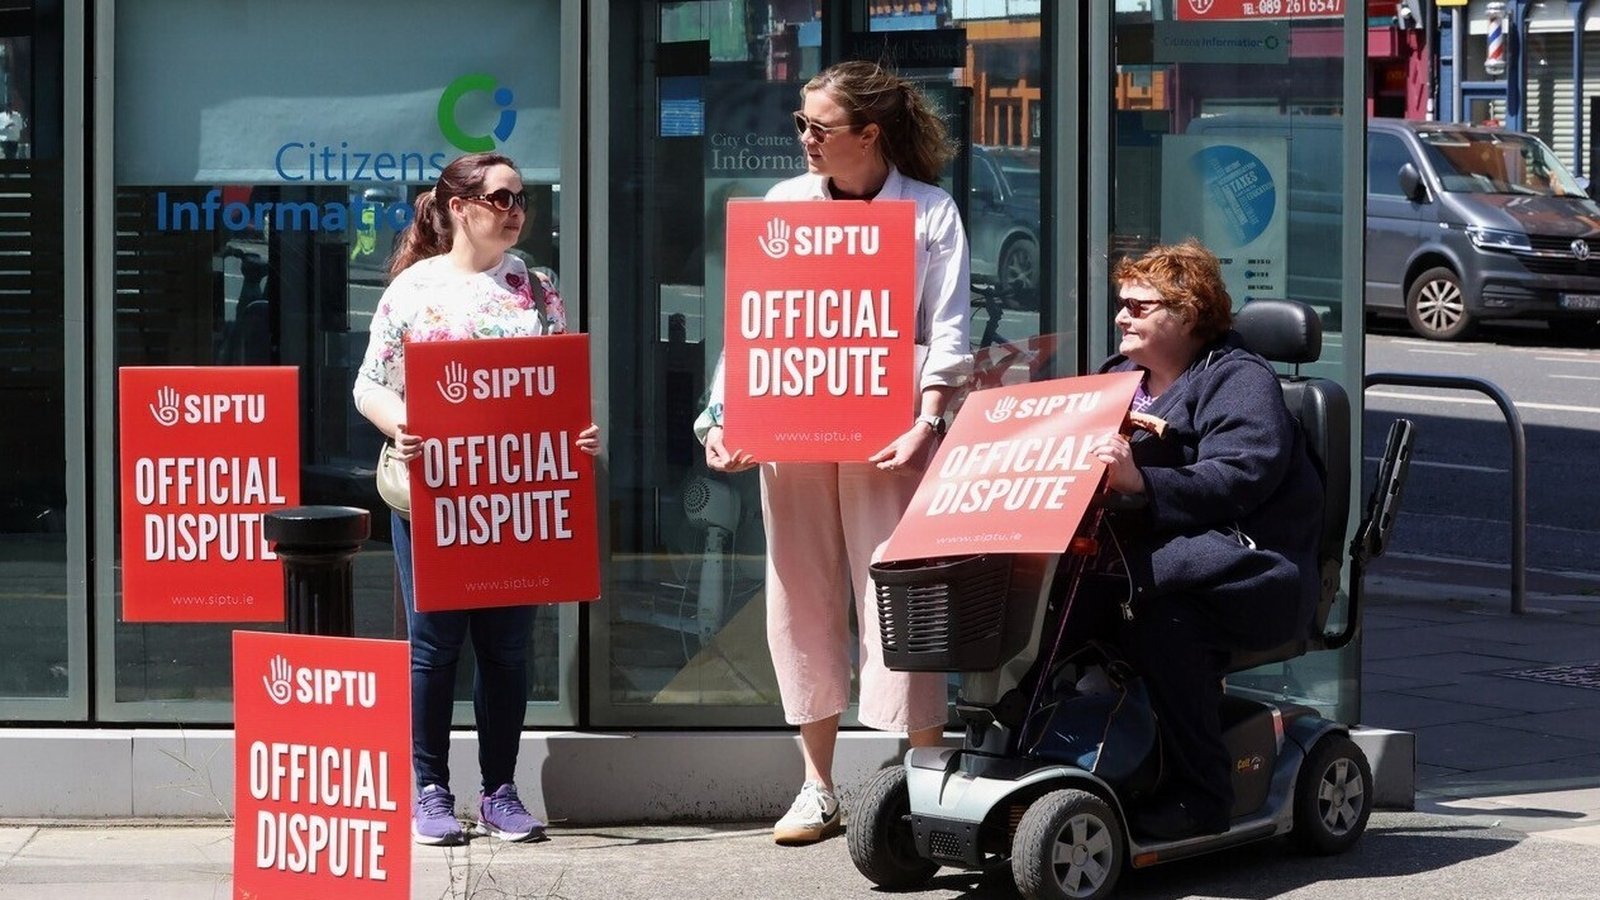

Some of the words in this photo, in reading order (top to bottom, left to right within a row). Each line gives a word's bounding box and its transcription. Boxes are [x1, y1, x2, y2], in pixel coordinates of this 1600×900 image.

[1259, 0, 1282, 13] 089
[1286, 0, 1307, 13] 261
[1309, 0, 1341, 12] 6547
[711, 133, 740, 149] City
[745, 132, 793, 146] Centre
[275, 142, 444, 182] Citizens
[711, 148, 806, 171] Informa
[1231, 170, 1259, 193] TAXES
[157, 187, 414, 232] Informatio
[794, 225, 880, 256] SIPTU
[741, 289, 899, 340] OFFICIAL
[472, 365, 556, 400] SIPTU
[749, 347, 890, 397] DISPUTE
[184, 394, 265, 424] SIPTU
[1014, 390, 1103, 420] SIPTU
[775, 430, 862, 443] www.siptu.ie
[424, 431, 579, 489] OFFICIAL
[938, 433, 1101, 481] OFFICIAL
[135, 456, 286, 505] OFFICIAL
[926, 475, 1076, 517] DISPUTE
[435, 490, 573, 547] DISPUTE
[935, 531, 1023, 545] www.siptu.ie
[172, 593, 254, 606] www.siptu.ie
[465, 576, 551, 593] www.siptu.ie
[296, 667, 377, 708] SIPTU
[250, 740, 397, 811] OFFICIAL
[257, 810, 388, 881] DISPUTE
